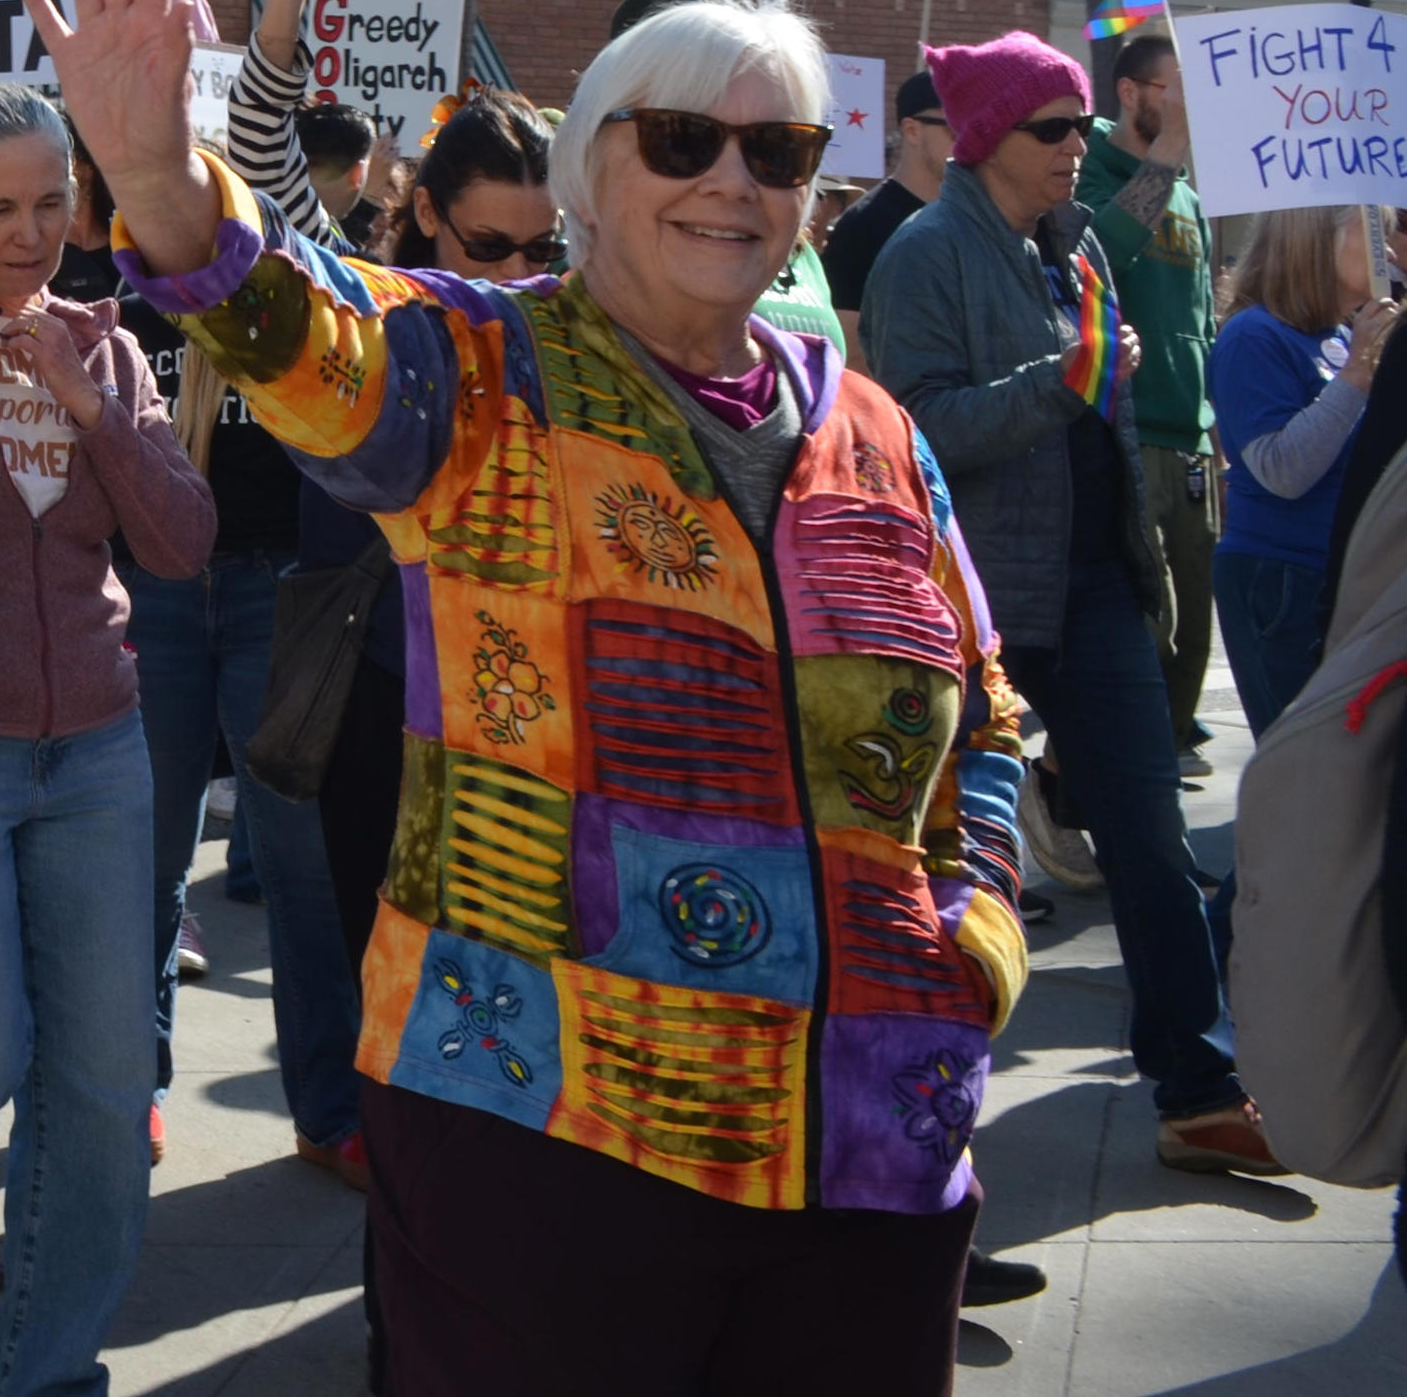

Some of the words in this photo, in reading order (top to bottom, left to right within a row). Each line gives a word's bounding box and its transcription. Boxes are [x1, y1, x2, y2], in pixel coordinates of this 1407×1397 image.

[1367, 15, 1396, 72] 4
[314, 46, 447, 103] Oligarch
[1273, 86, 1390, 130] YOUR
[1252, 136, 1407, 188] FUTURE
